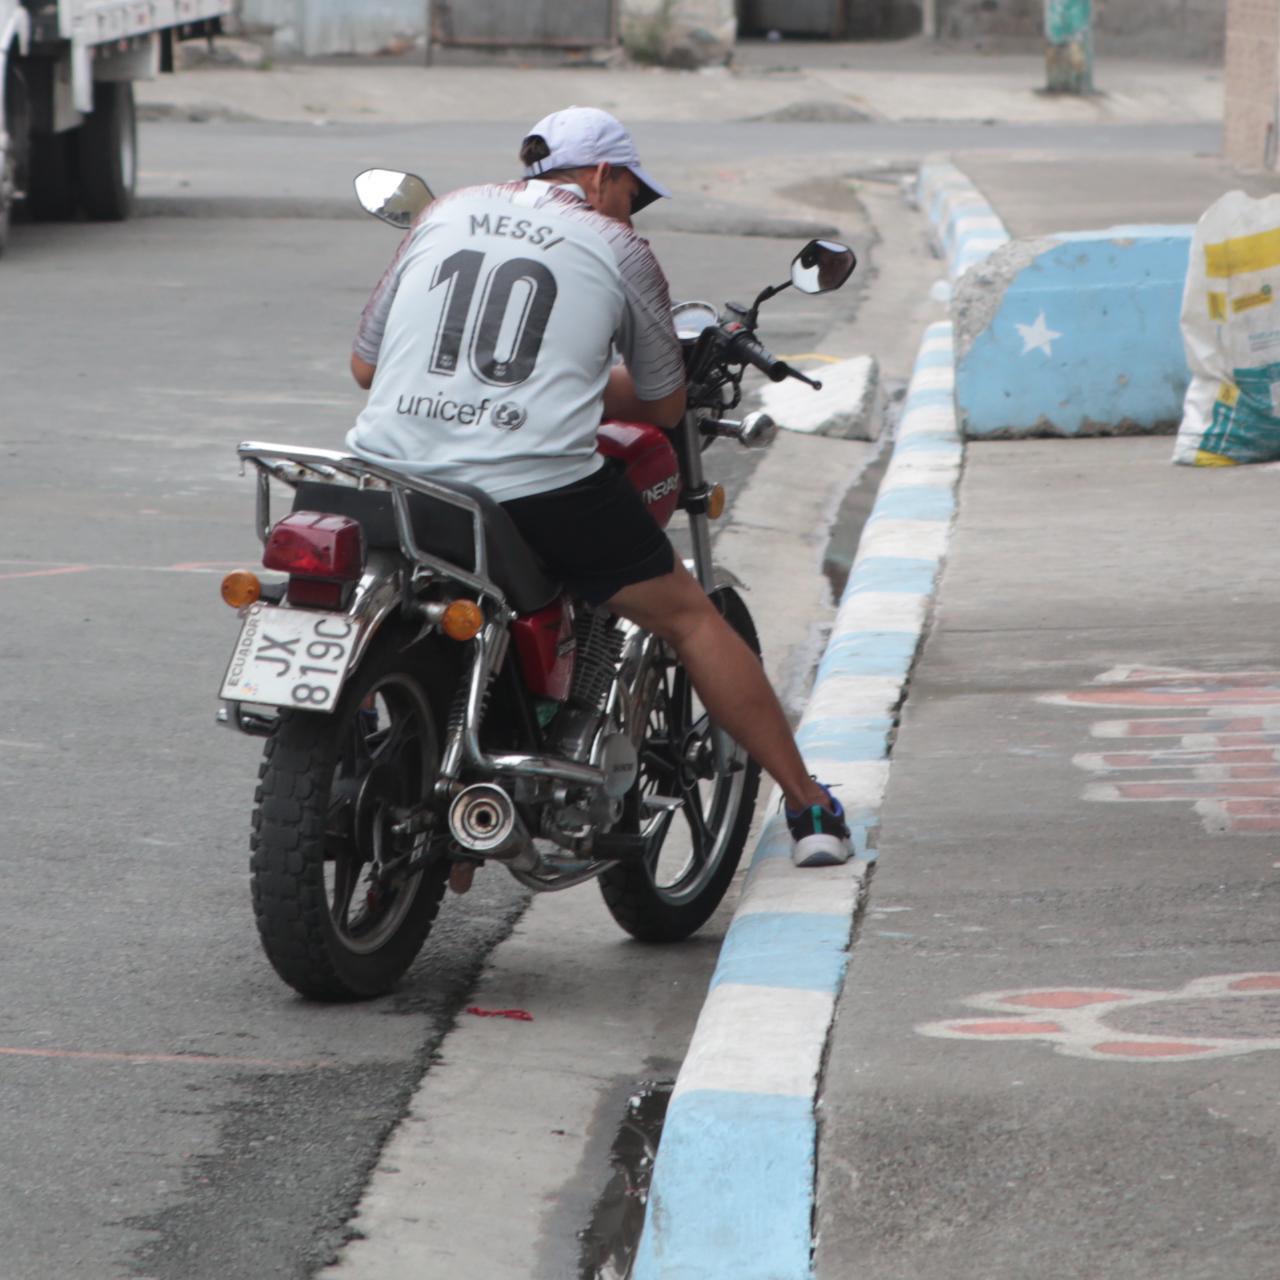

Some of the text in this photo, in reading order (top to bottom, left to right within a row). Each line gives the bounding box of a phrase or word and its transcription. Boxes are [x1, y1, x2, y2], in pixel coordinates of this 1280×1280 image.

[469, 213, 565, 251] MESSI
[427, 248, 558, 388] 10
[396, 392, 491, 426] unicef
[227, 619, 259, 687] ECUADOR
[254, 633, 301, 677] JX
[291, 619, 352, 705] 819C
